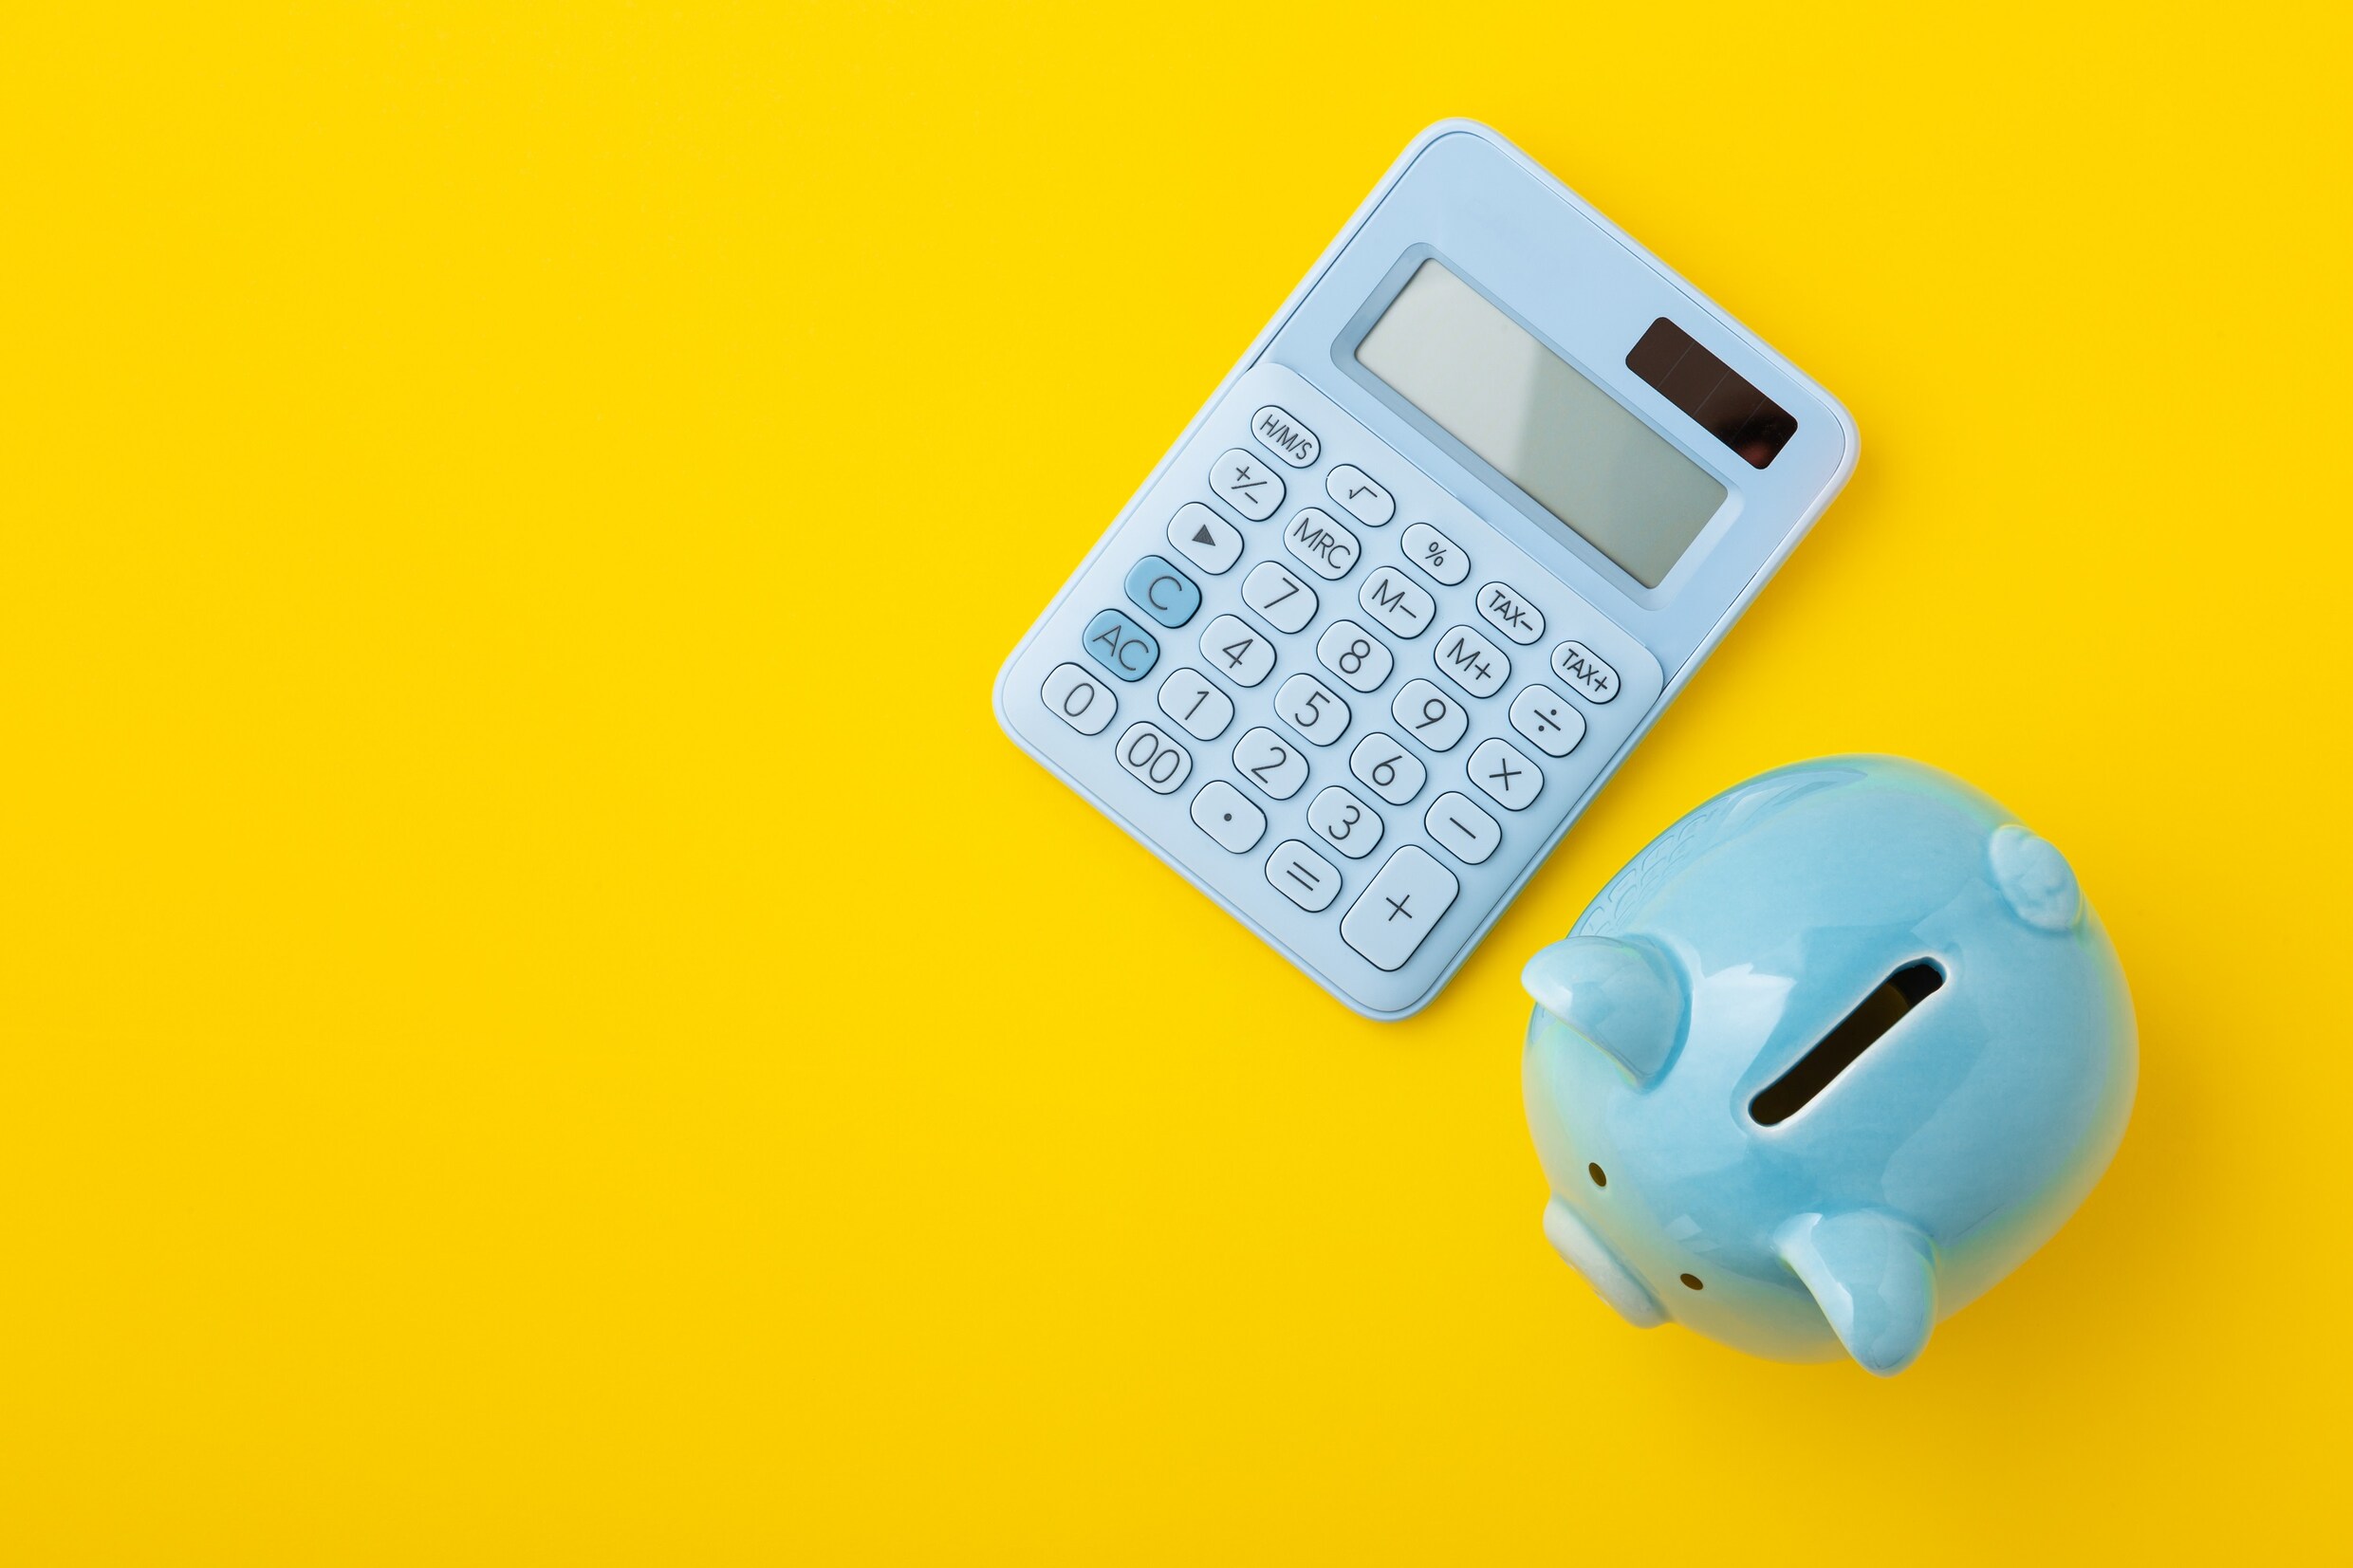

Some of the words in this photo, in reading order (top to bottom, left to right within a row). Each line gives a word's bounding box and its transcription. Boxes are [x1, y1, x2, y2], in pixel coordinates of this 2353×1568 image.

[1259, 414, 1313, 460] H/M/S
[1292, 517, 1351, 570] MRC
[1424, 541, 1448, 567] %
[1148, 575, 1183, 611] C
[1263, 577, 1300, 610] 7
[1092, 624, 1150, 672] AC
[1221, 637, 1254, 670] 4
[1338, 638, 1371, 675] 8
[1446, 636, 1491, 681] M+
[1562, 648, 1608, 692] TAX+
[1063, 682, 1096, 718] 0
[1183, 691, 1210, 721] 1
[1294, 690, 1331, 728] 5
[1415, 697, 1447, 730] 9
[1127, 732, 1181, 784] 00
[1251, 746, 1288, 784] 2
[1371, 754, 1403, 787] 6
[1327, 804, 1362, 841] 3
